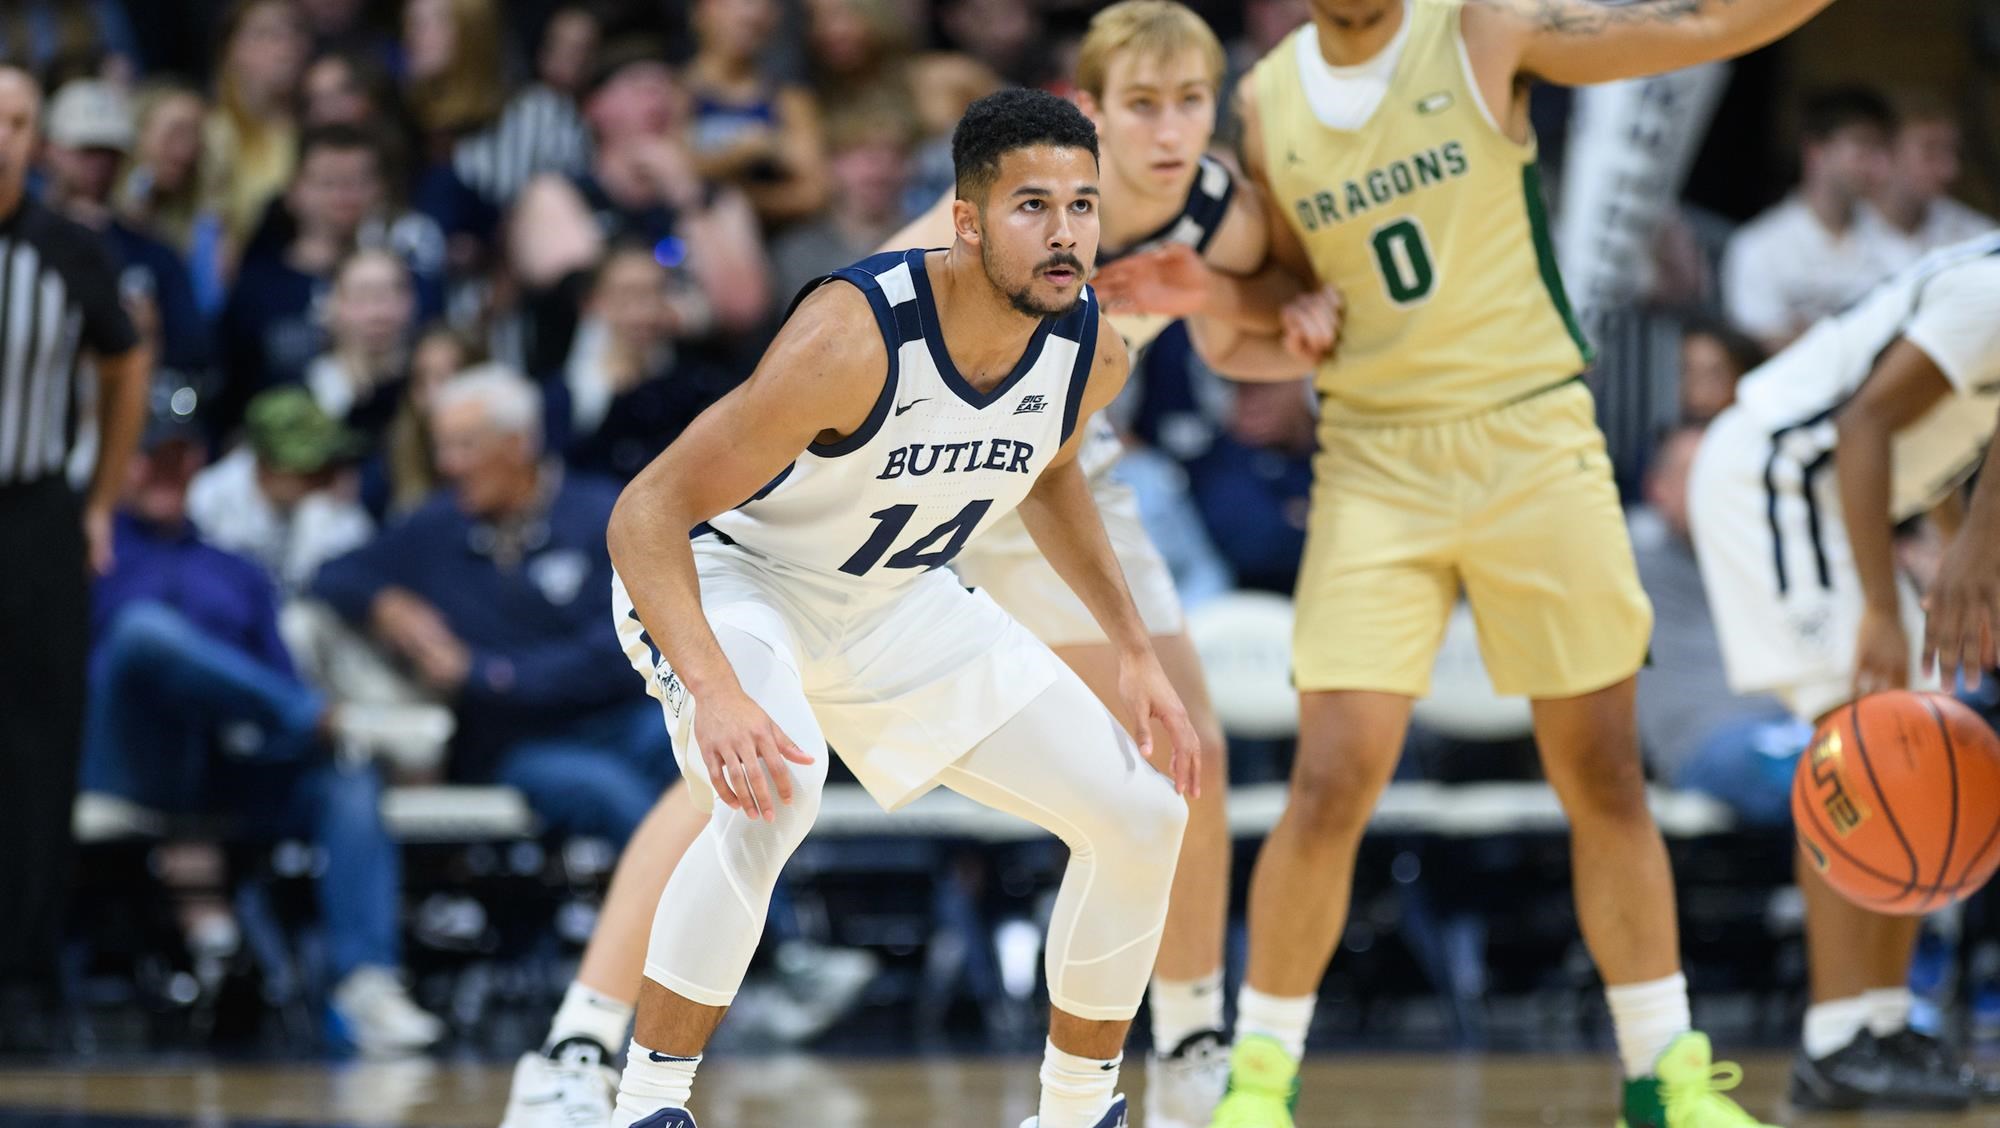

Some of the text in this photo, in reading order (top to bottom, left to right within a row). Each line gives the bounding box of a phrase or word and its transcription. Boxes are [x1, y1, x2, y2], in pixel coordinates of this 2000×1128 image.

[1296, 141, 1468, 231] DRAGONS
[1370, 218, 1434, 305] 0
[1015, 402, 1049, 412] EAST
[1021, 394, 1045, 404] BIG
[876, 438, 1034, 480] BUTLER
[838, 498, 994, 576] 14
